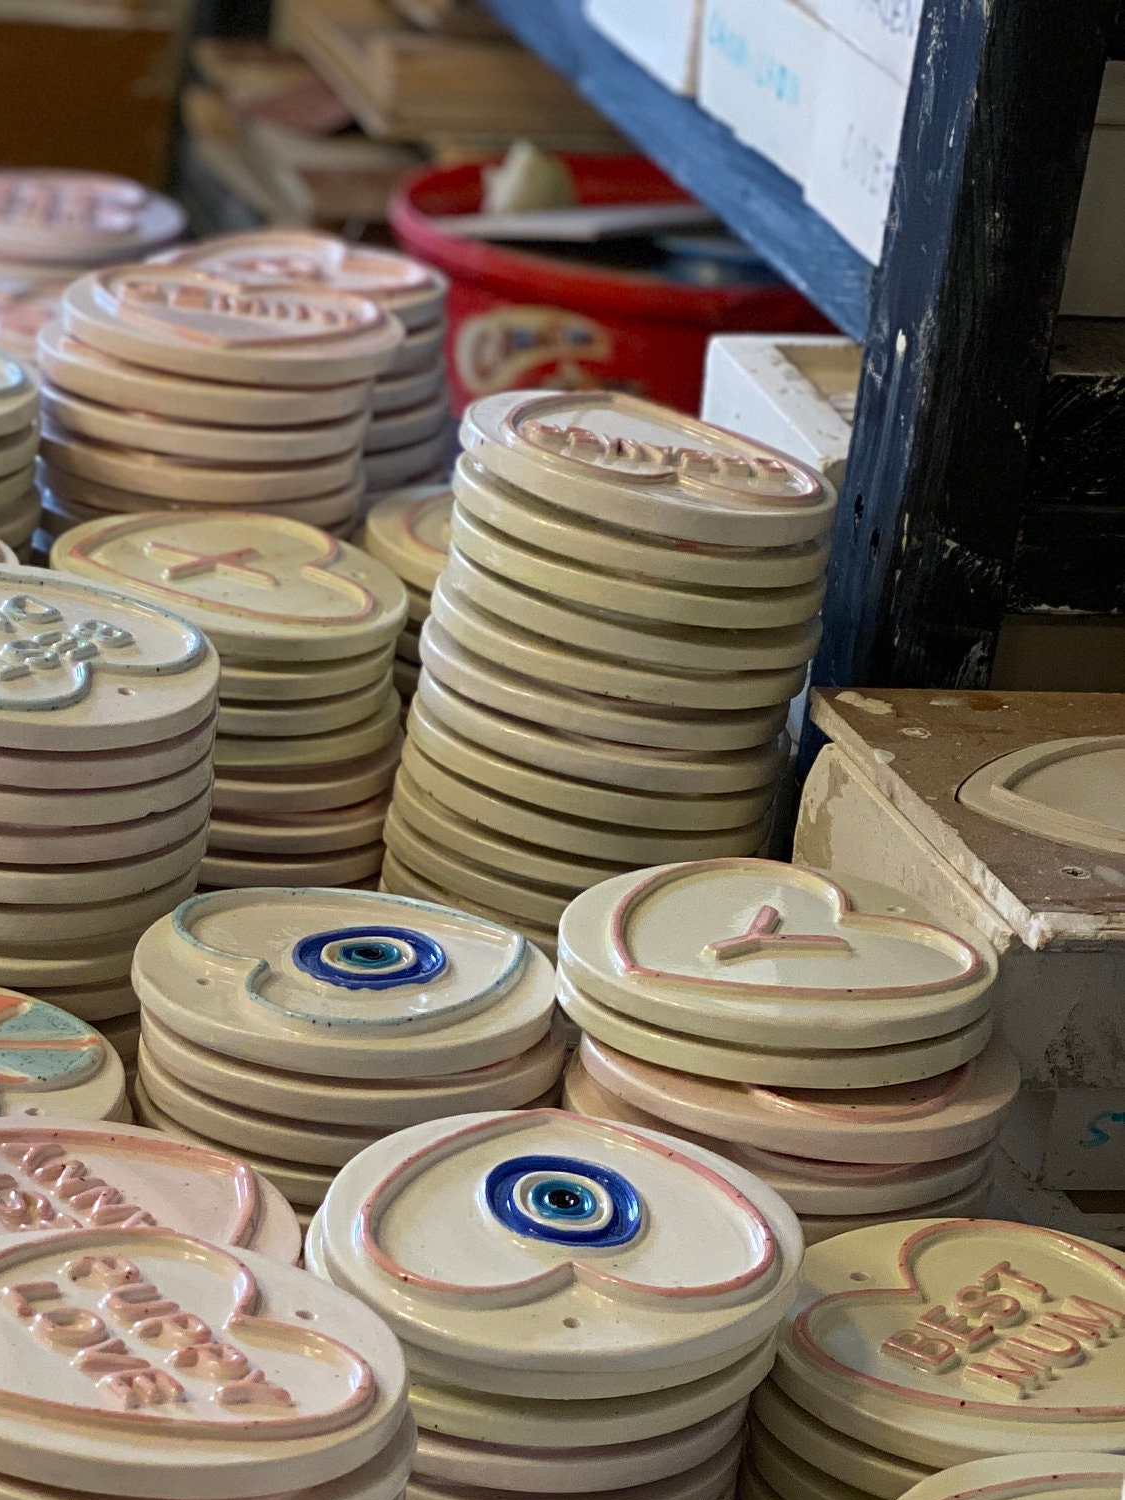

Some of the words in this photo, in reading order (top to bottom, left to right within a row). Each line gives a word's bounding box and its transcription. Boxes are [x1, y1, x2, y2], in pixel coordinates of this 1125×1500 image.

[143, 540, 279, 588] X
[701, 904, 853, 965] Y
[57, 1255, 295, 1407] PUPPY
[880, 1260, 1050, 1375] BEST
[962, 1294, 1125, 1400] MUM
